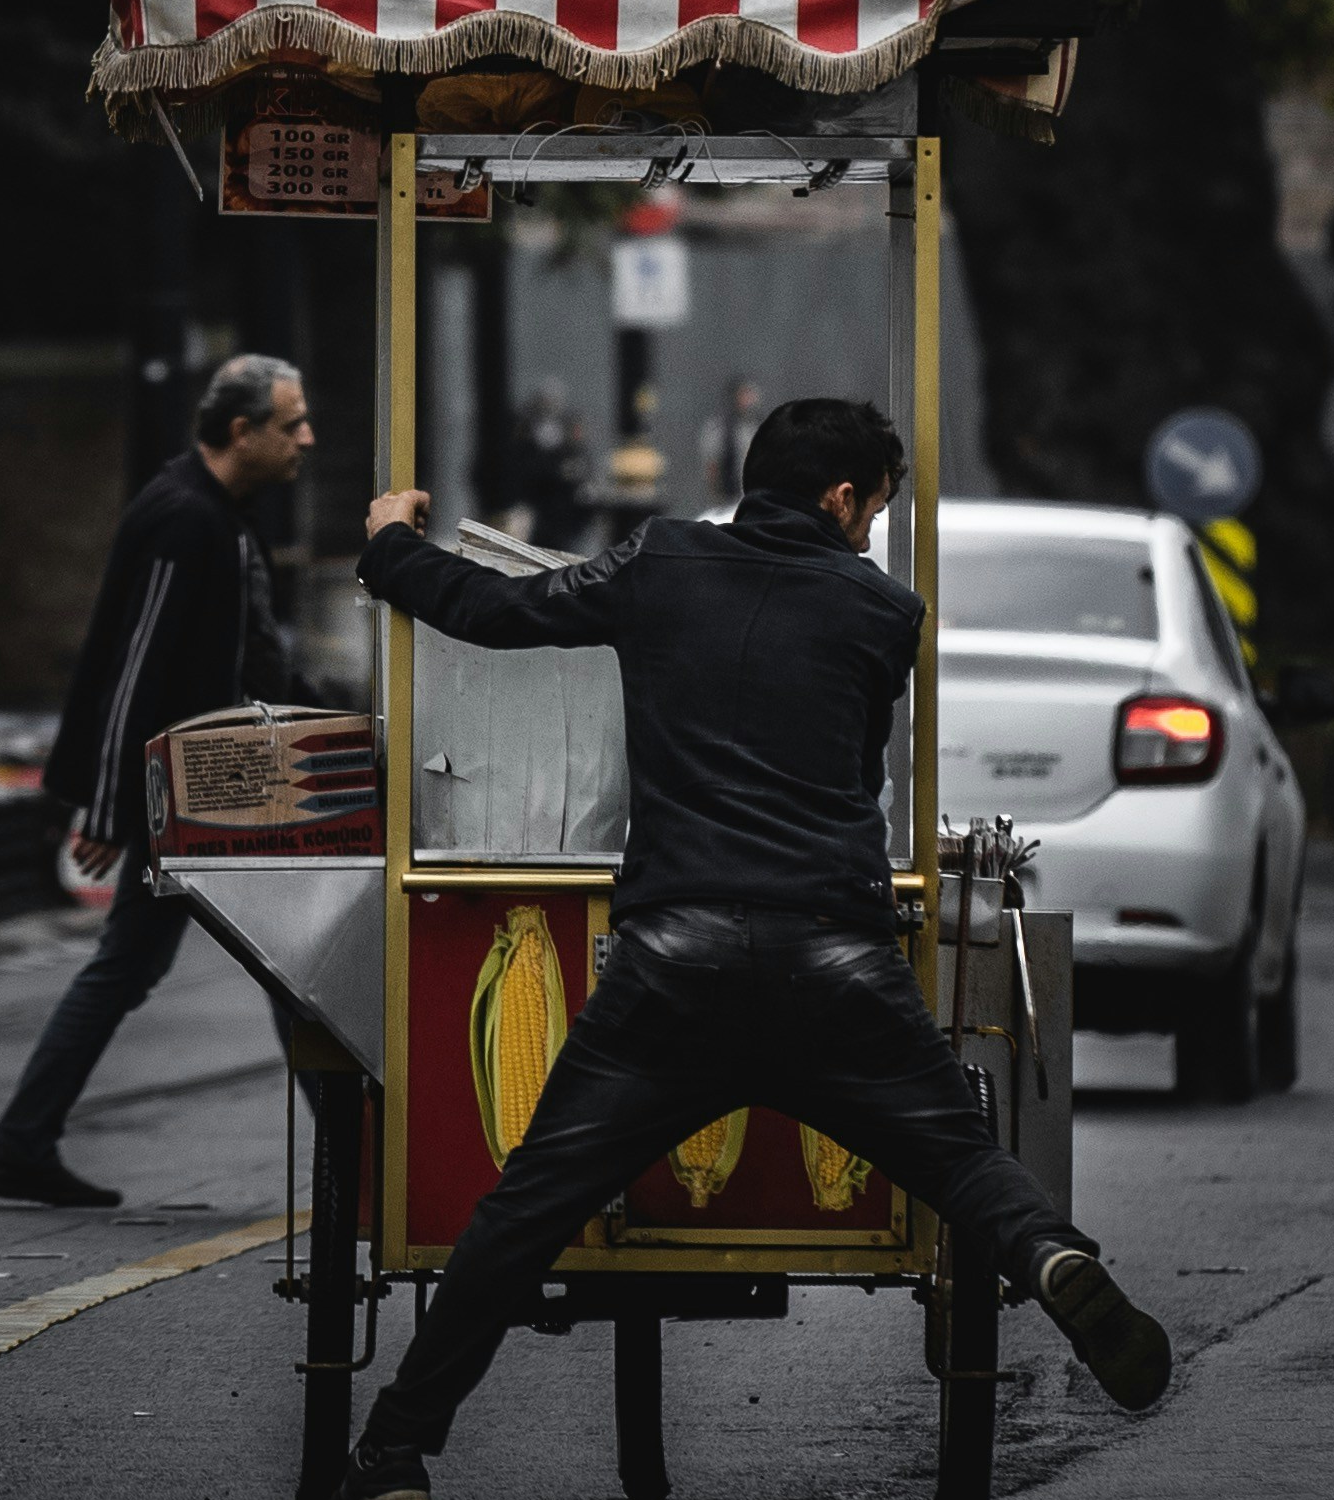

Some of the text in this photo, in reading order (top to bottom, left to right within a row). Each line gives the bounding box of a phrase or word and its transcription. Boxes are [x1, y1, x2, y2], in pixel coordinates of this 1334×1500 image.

[270, 129, 350, 144] 100 GR
[269, 147, 349, 162] 150 GR
[268, 164, 349, 179] 200 GR
[267, 181, 446, 199] 300 GR TL
[311, 752, 370, 769] EKONOMİK
[317, 793, 373, 808] DUMANSIZ
[303, 825, 373, 847] KÖMÜRÜ
